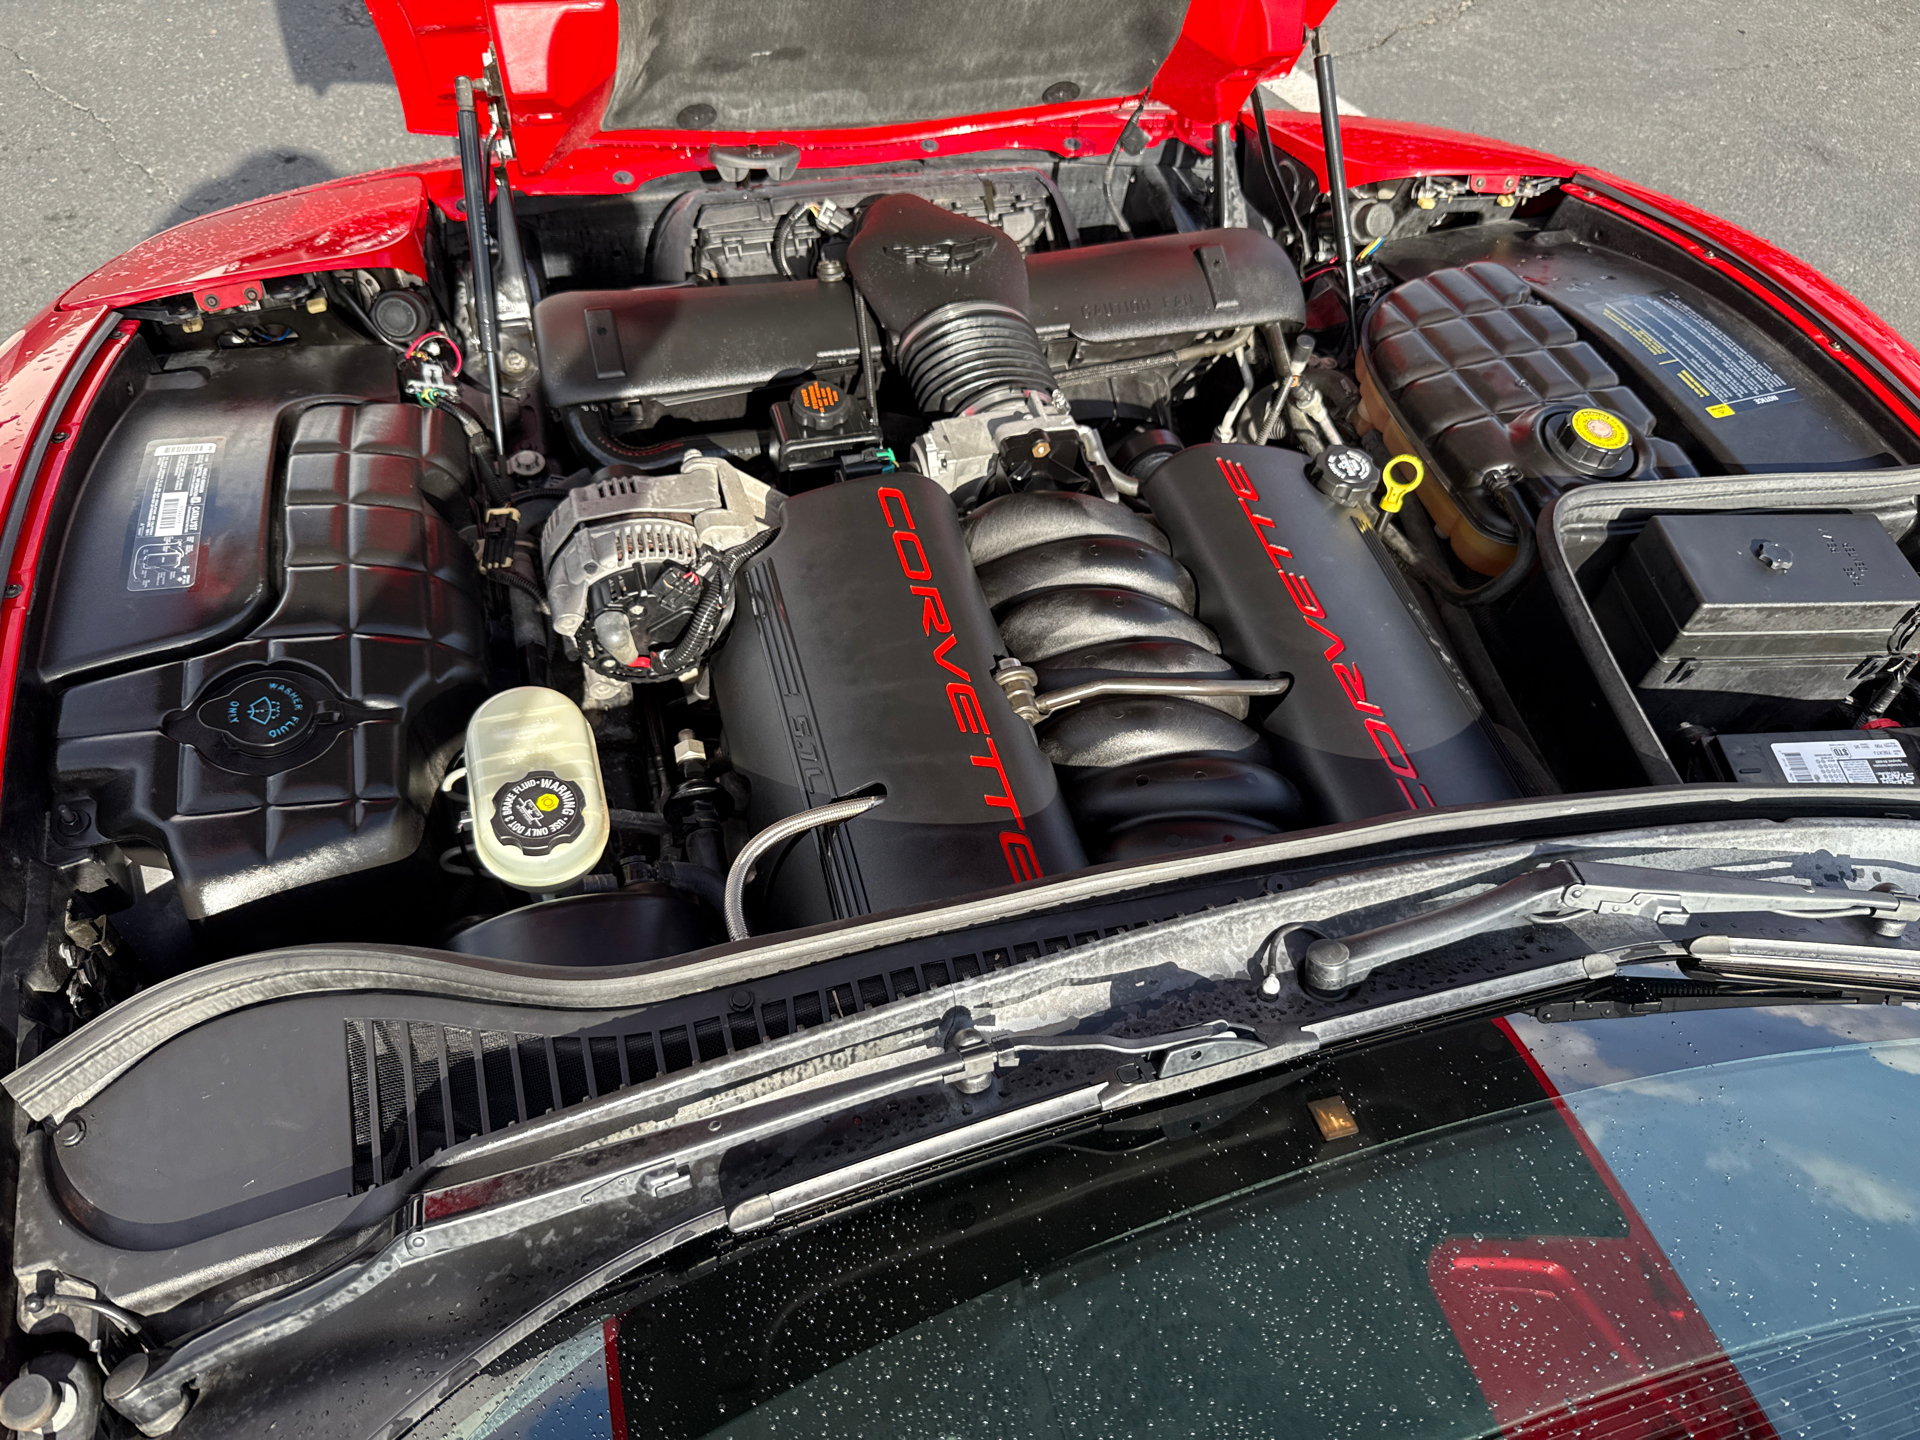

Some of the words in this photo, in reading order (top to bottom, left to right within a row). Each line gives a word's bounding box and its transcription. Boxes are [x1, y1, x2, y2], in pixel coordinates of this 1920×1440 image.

[1080, 299, 1152, 319] CAUTION
[1161, 294, 1194, 309] FAN
[1753, 395, 1779, 405] NOTICE
[189, 506, 201, 531] CATALYST
[269, 682, 304, 711] WASHER
[876, 486, 1043, 885] CORVETTE
[228, 700, 240, 724] ONLY
[268, 715, 300, 738] FLUID
[790, 714, 824, 794] 5.7L
[1833, 748, 1848, 756] STD
[512, 779, 537, 795] FLUID
[1879, 772, 1915, 780] START
[502, 792, 517, 816] BRAKE
[540, 778, 576, 816] WARNING
[507, 820, 526, 834] DOT
[524, 827, 549, 837] ONLY
[549, 819, 567, 833] USE
